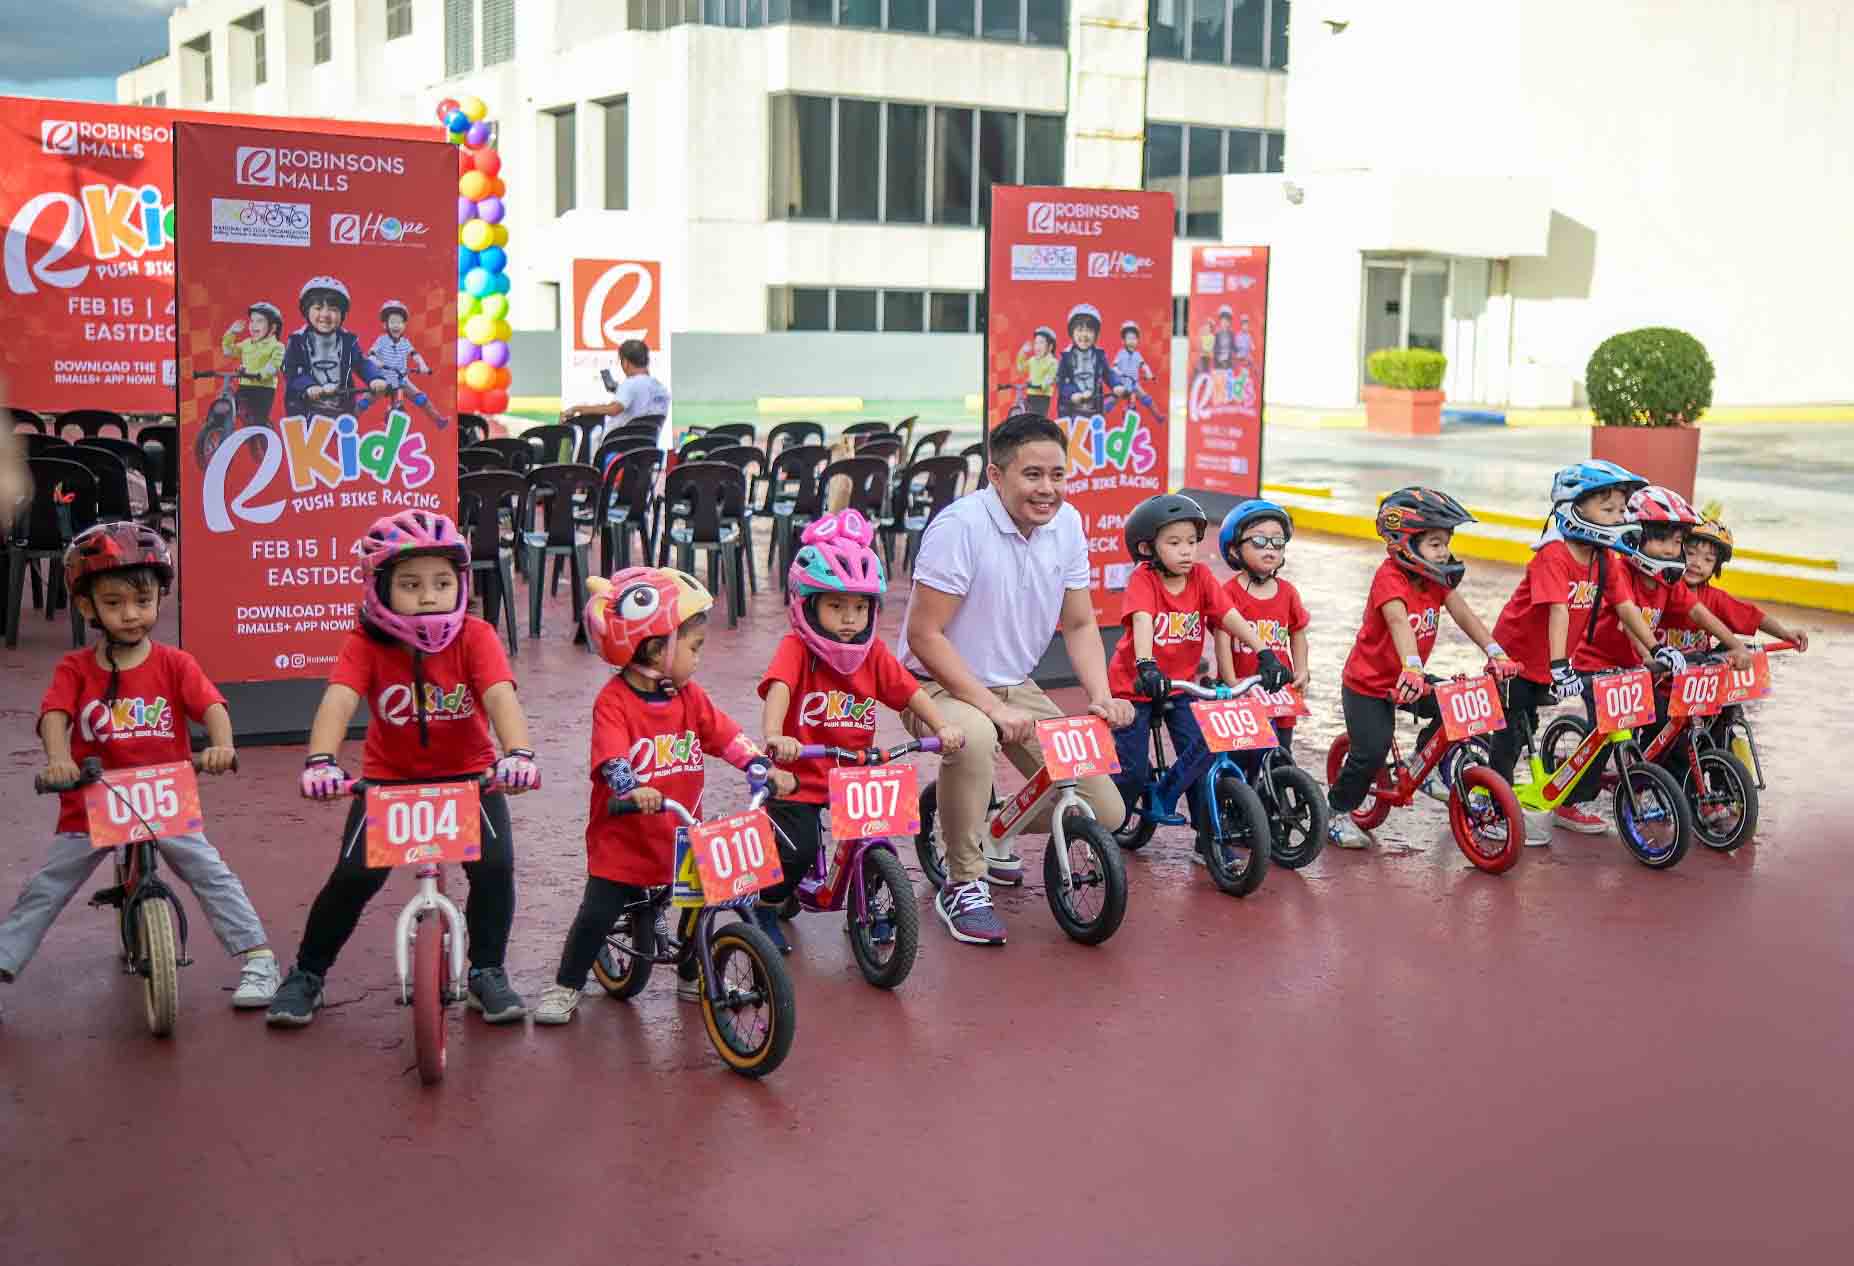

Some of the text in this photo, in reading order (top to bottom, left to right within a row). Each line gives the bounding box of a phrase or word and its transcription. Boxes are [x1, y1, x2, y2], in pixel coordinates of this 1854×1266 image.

[80, 122, 174, 144] ROBINSO
[80, 142, 145, 160] MALLS
[279, 148, 405, 176] ROBINSONS
[279, 172, 349, 193] MALLS
[81, 184, 175, 259] Ki
[1055, 203, 1140, 219] ROBINSONS
[1056, 220, 1103, 236] MALLS
[96, 259, 174, 280] PUSH BIK
[68, 297, 106, 315] FEB
[112, 297, 134, 316] 15
[165, 298, 176, 316] 4
[84, 323, 176, 342] EASTDEC
[54, 360, 157, 373] DOWNLOAD THE
[104, 374, 125, 385] APP
[280, 410, 435, 492] Kids
[1056, 409, 1157, 478] Kids
[1064, 479, 1089, 494] USH
[1119, 473, 1159, 489] RACING
[293, 489, 440, 512] PUSH BIKE RACING
[252, 540, 290, 559] FEB
[296, 539, 318, 558] 15
[268, 566, 364, 586] EASTDEC
[237, 603, 356, 619] DOWNLOAD THE
[238, 619, 355, 634] RMALLS+ APP NOW!
[1606, 684, 1644, 718] 002
[1682, 675, 1719, 704] 003
[109, 696, 173, 731] Kids
[826, 690, 876, 724] Kids
[1451, 687, 1493, 723] 008
[1209, 709, 1259, 738] 009
[1052, 727, 1102, 763] 001
[107, 778, 178, 825] 005
[846, 780, 900, 820] 007
[387, 799, 461, 845] 004
[710, 827, 765, 880] 010
